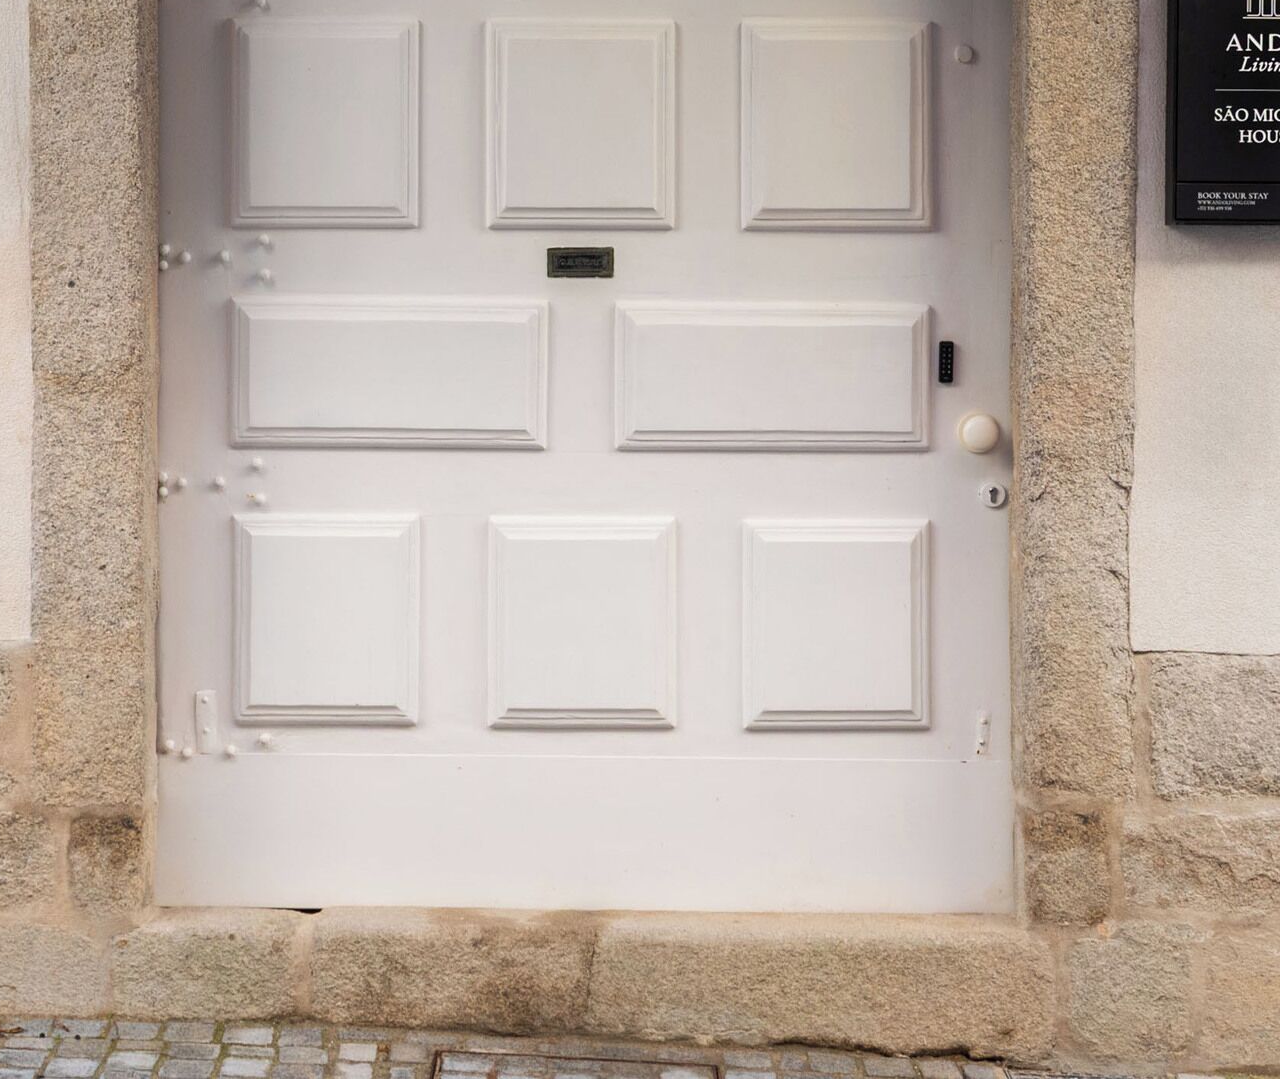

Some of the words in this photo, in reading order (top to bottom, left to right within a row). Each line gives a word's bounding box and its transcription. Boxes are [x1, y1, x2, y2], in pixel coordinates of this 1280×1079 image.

[1214, 105, 1249, 122] SÃO
[1197, 192, 1221, 200] BOOK
[1223, 192, 1247, 200] YOUR
[1248, 192, 1269, 200] STAY
